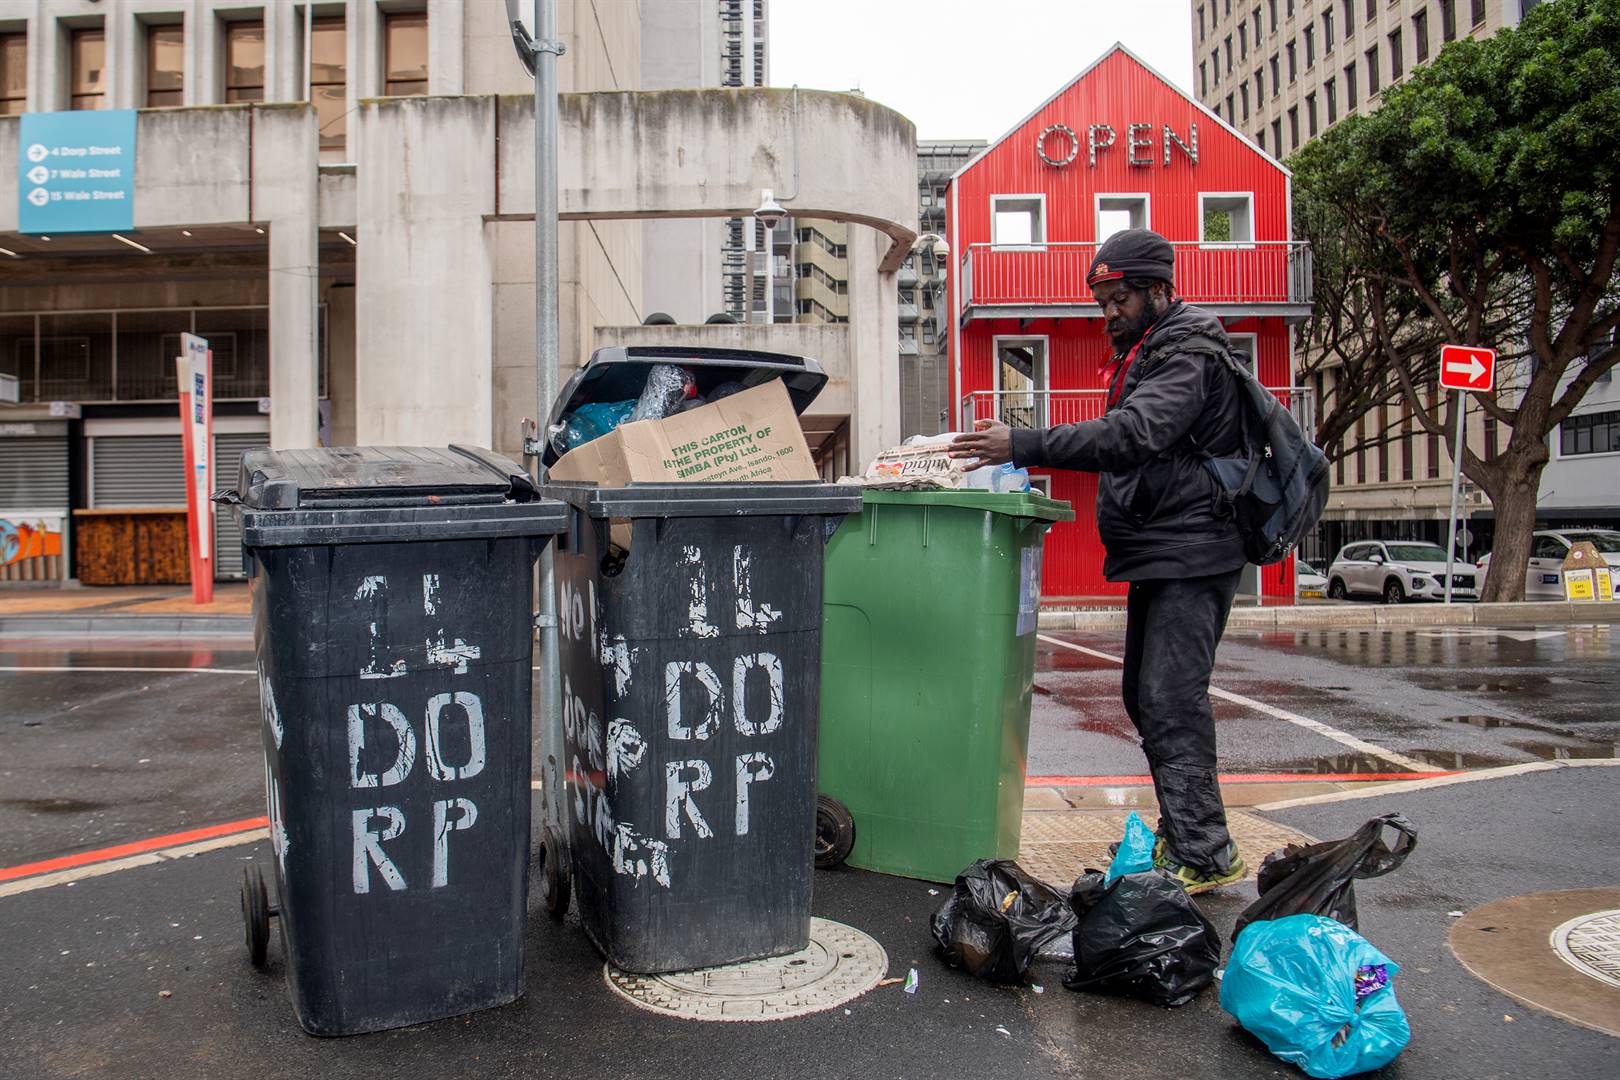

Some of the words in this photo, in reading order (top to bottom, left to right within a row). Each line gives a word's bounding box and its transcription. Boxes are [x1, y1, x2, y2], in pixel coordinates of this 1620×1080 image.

[51, 147, 60, 156] 4
[60, 146, 88, 157] Dorp
[89, 145, 122, 155] Street
[1037, 123, 1198, 167] OPEN
[50, 169, 58, 178] 7
[60, 168, 87, 178] Wale
[88, 168, 121, 178] Street
[50, 191, 62, 201] 15
[63, 190, 91, 200] Wale
[92, 190, 125, 200] Street
[671, 441, 698, 456] THIS
[701, 424, 747, 446] CARTON
[672, 455, 692, 468] THE
[694, 433, 753, 461] PROPERTY
[756, 427, 772, 439] OF
[776, 446, 794, 457] 1600
[676, 461, 712, 479] SIMBA
[713, 451, 738, 467] (Pty)
[740, 444, 762, 457] Ltd.
[902, 459, 952, 474] Nulaid
[750, 466, 772, 478] Africa
